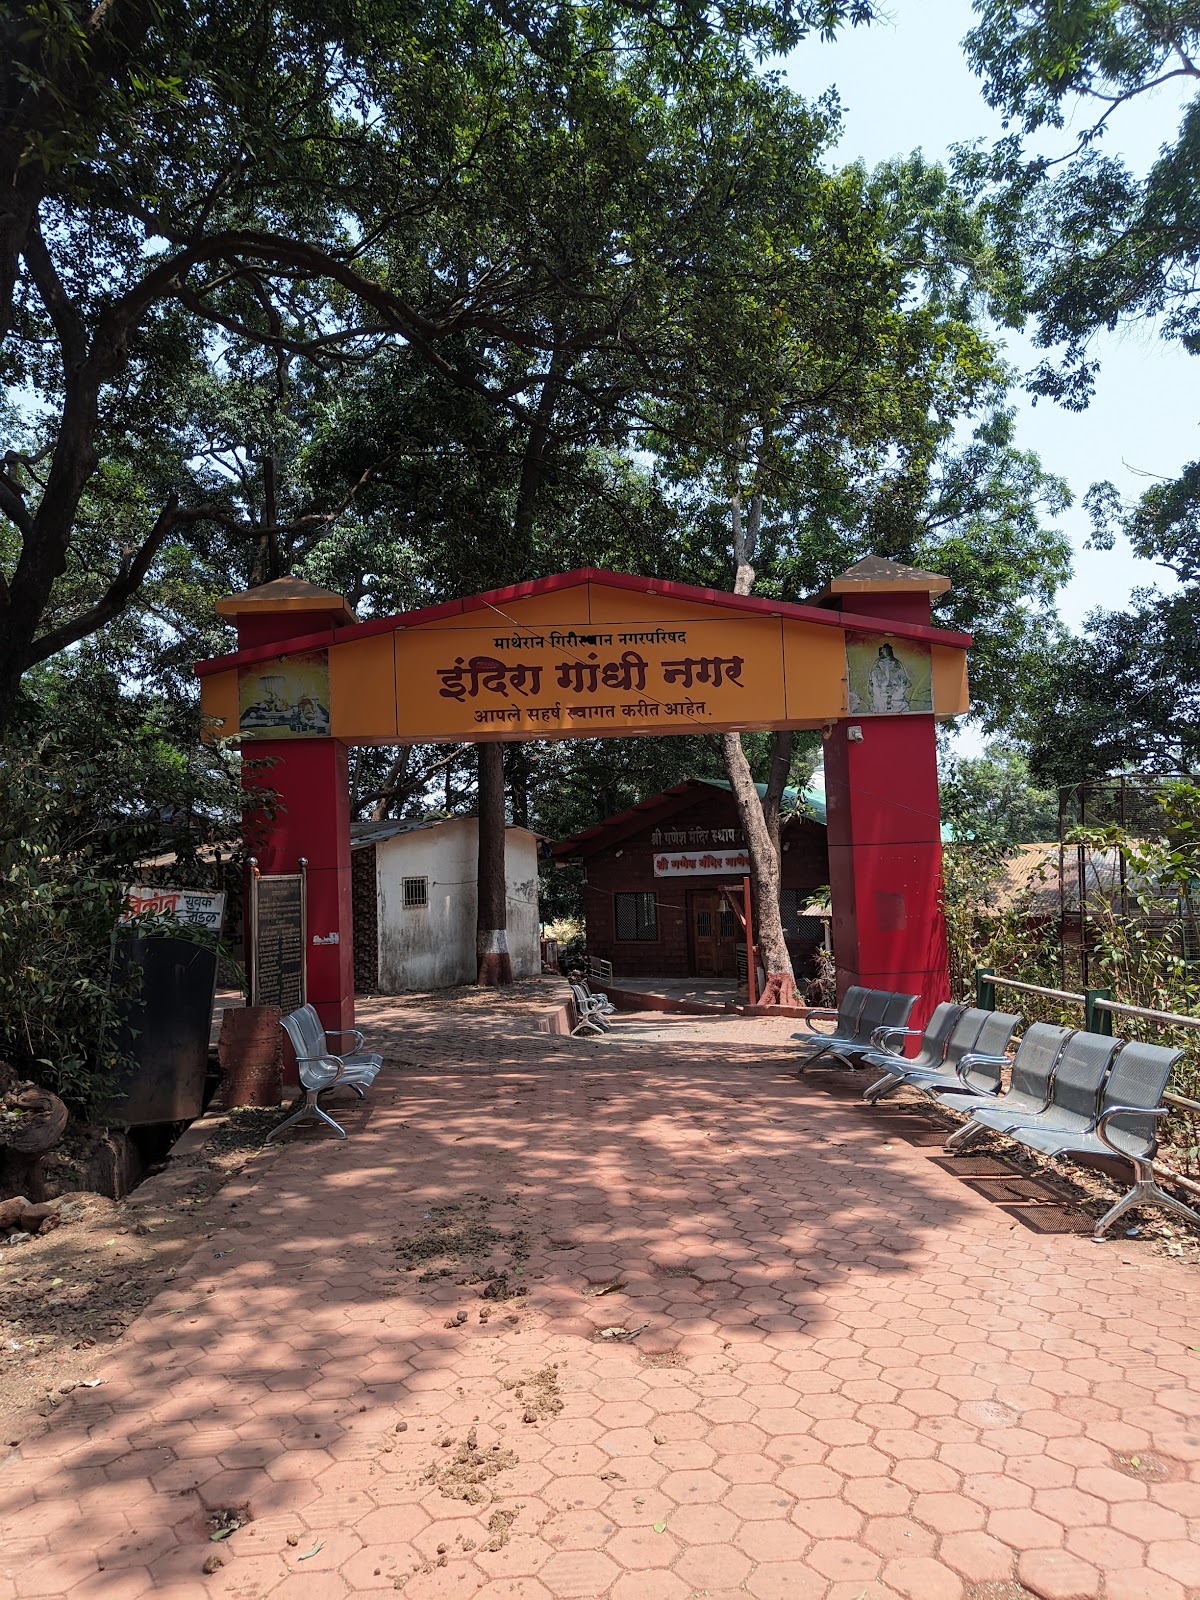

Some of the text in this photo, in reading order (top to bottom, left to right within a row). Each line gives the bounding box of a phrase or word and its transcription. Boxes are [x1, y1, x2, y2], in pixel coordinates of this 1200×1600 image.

[493, 633, 544, 649] माथेरान
[617, 628, 687, 645] नगरपरिषद
[437, 651, 744, 702] इंदिरा गांधी नगर
[474, 704, 521, 722] आपले
[526, 702, 561, 722] सहर्ष
[566, 706, 615, 720] स्वागत
[620, 700, 660, 717] करीत
[652, 828, 662, 845] श्री
[664, 827, 687, 845] गणेश
[688, 826, 709, 845] मंदिर
[657, 857, 669, 870] श्री
[671, 856, 697, 869] गणेश
[699, 854, 722, 869] मंदिर
[184, 896, 215, 909] युवक
[186, 907, 220, 923] मंडळ
